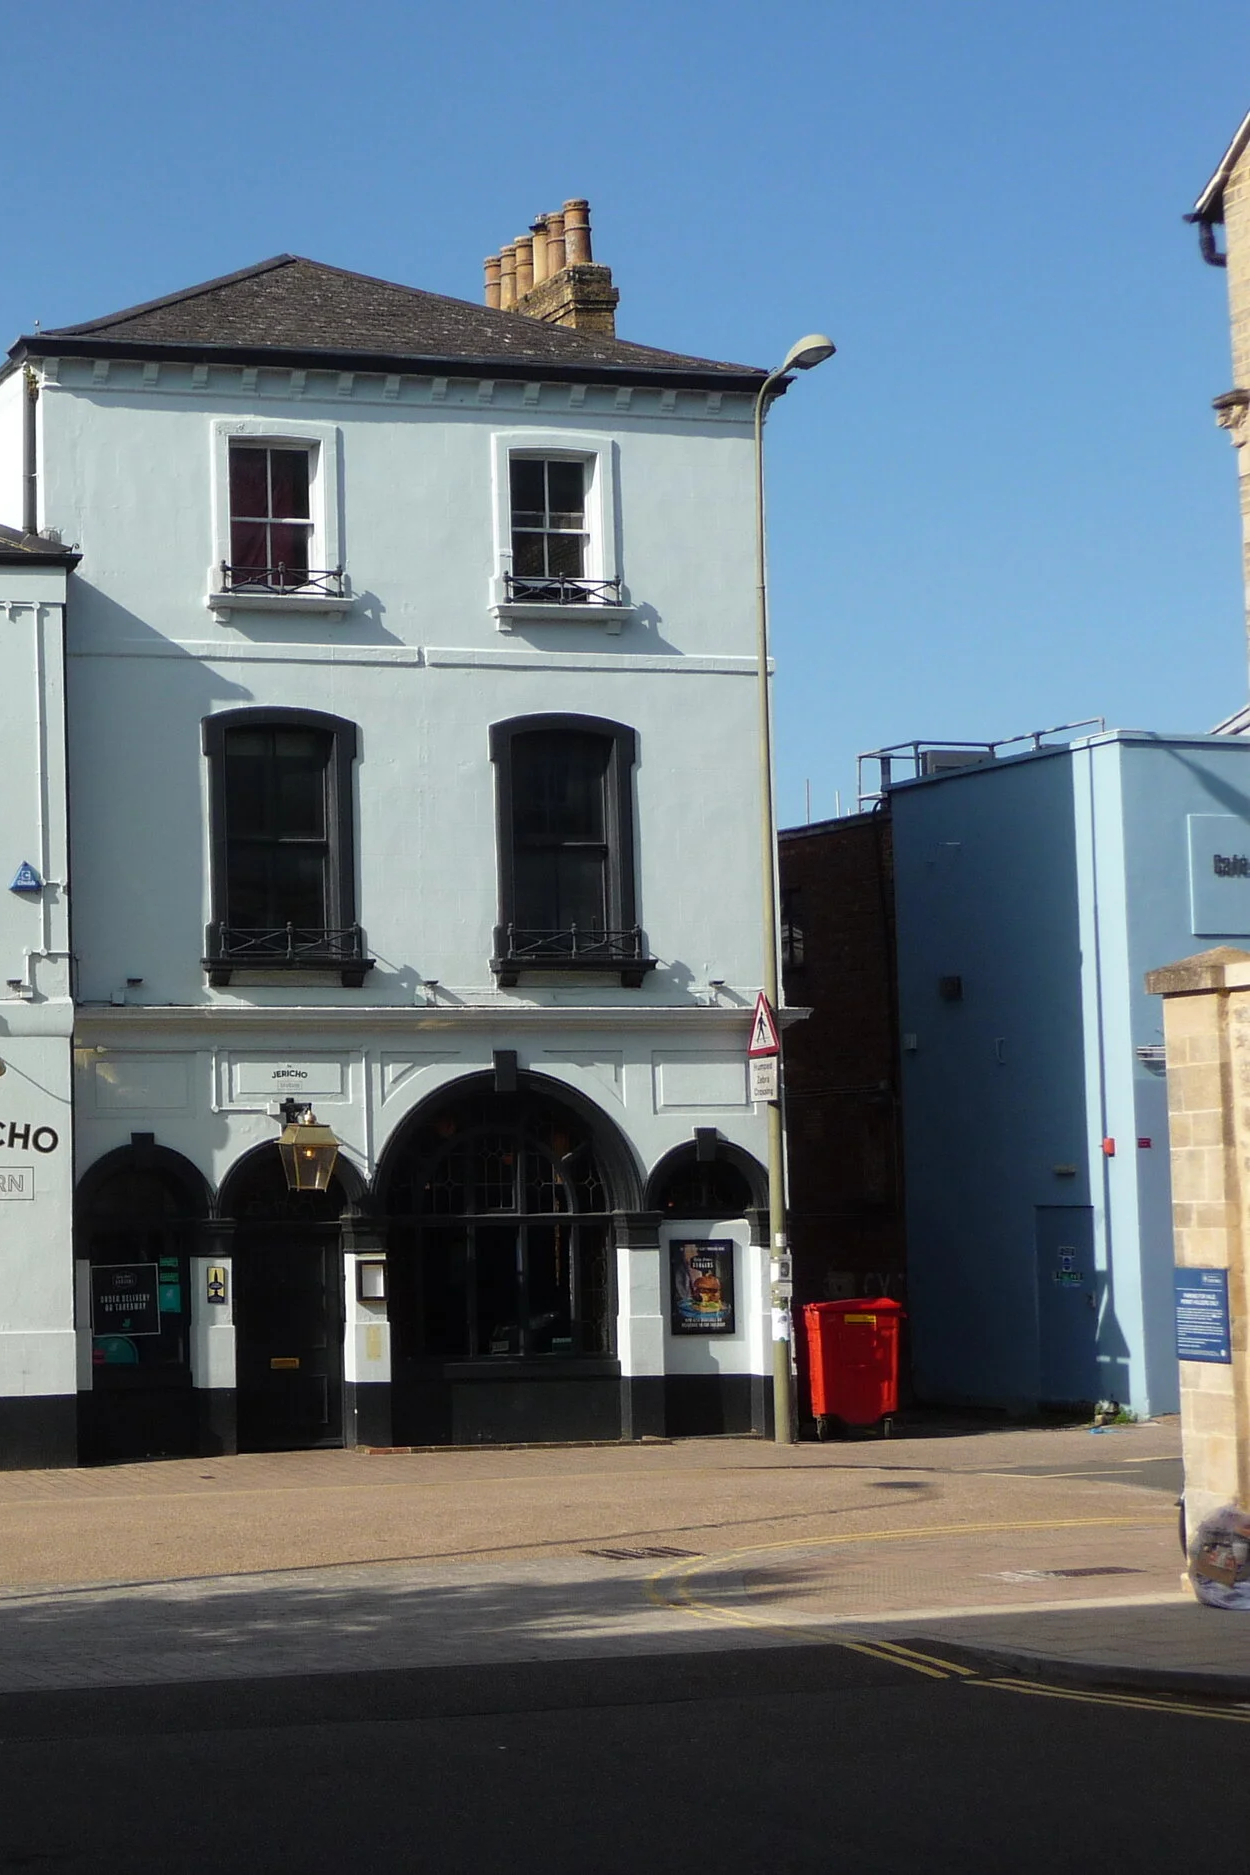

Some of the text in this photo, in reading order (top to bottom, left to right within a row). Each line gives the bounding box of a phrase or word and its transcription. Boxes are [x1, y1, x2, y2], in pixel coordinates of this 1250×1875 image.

[271, 1070, 307, 1078] JERICHO
[757, 1075, 769, 1084] Zebra
[754, 1088, 773, 1096] Crossing
